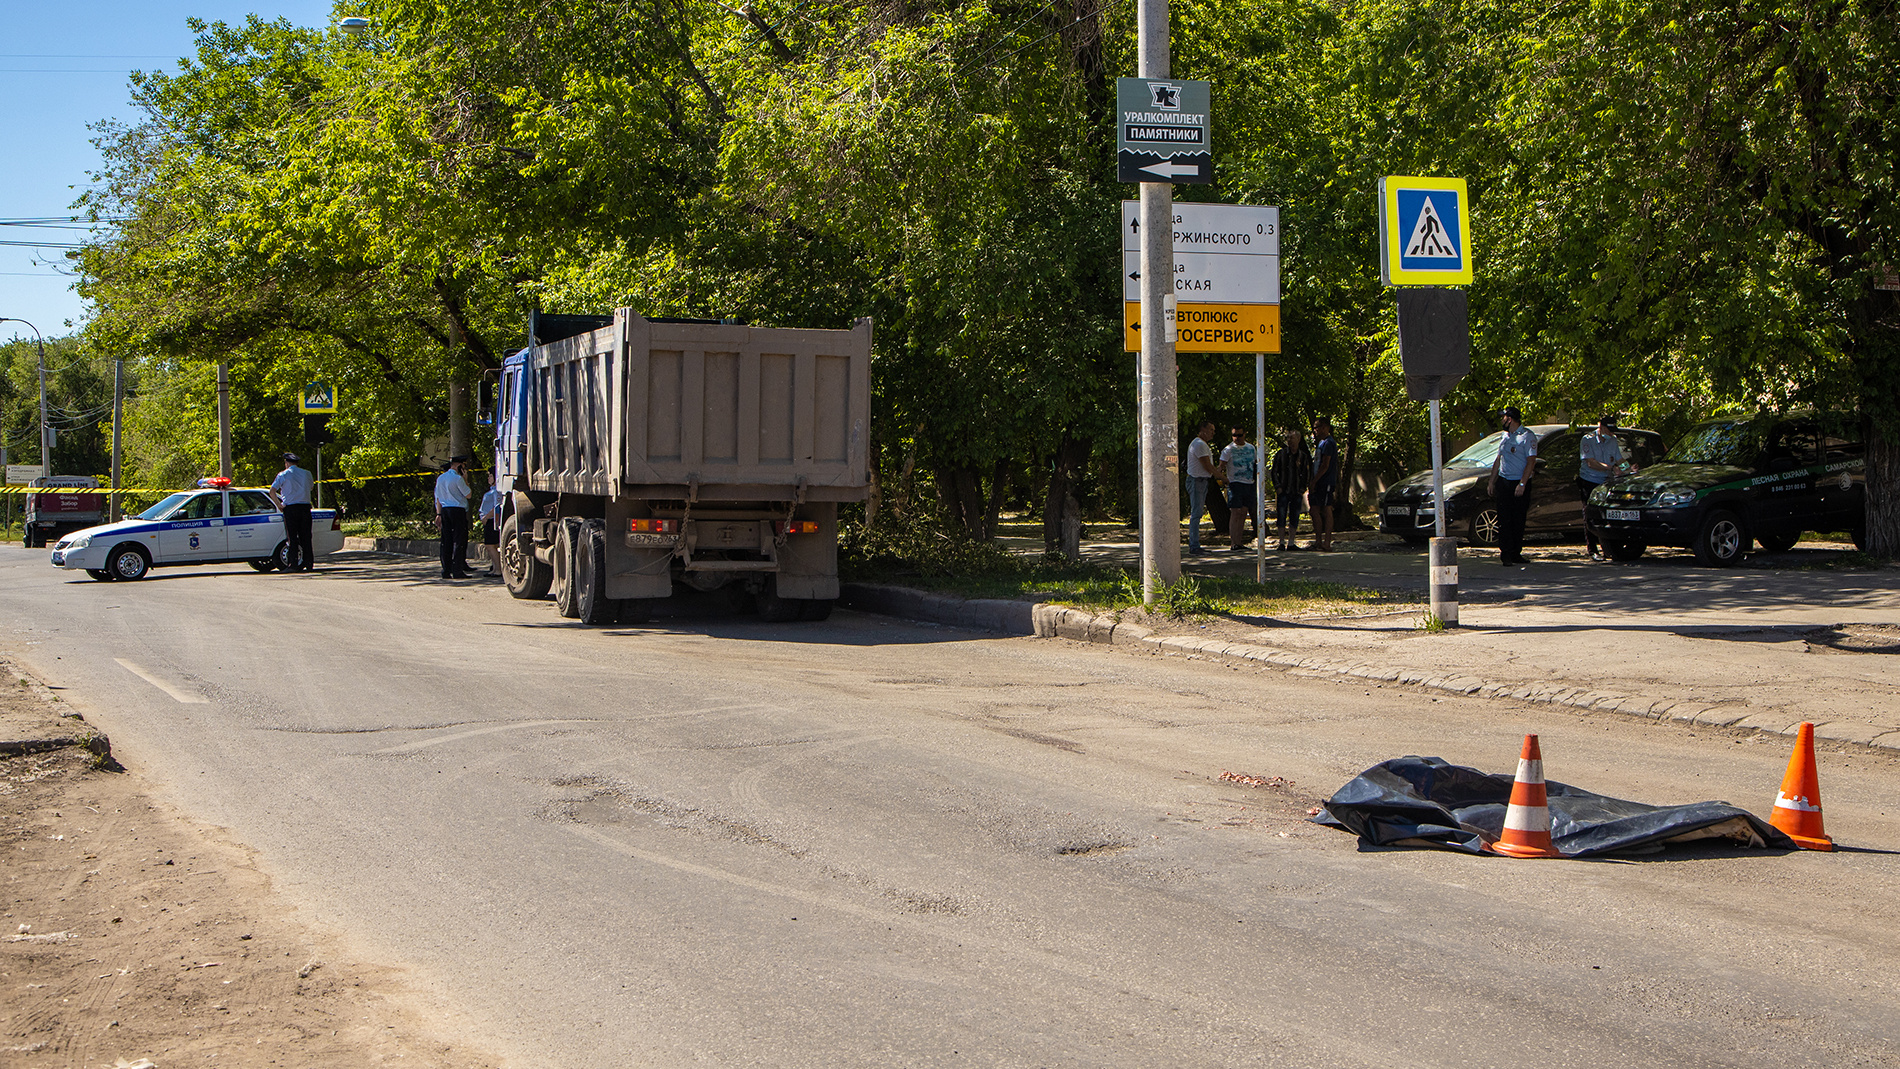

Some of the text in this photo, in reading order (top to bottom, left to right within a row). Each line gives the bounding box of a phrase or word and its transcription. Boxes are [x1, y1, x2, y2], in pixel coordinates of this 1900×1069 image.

[1124, 111, 1204, 125] УРАЛКОМПЛЕКТ
[1131, 127, 1199, 141] ПАМЯТНИКИ
[1173, 223, 1275, 245] РЖИНСКОГО 0.3
[1175, 279, 1212, 291] СКАЯ
[1177, 311, 1238, 323] ВТОЛЮКС
[1176, 323, 1275, 343] ТОСЕРВИС 0.1
[1751, 458, 1865, 486] ЛЕСНАЯ ОХРАНА САМАРСКОЙ
[171, 521, 204, 529] ПОЛИЦИЯ
